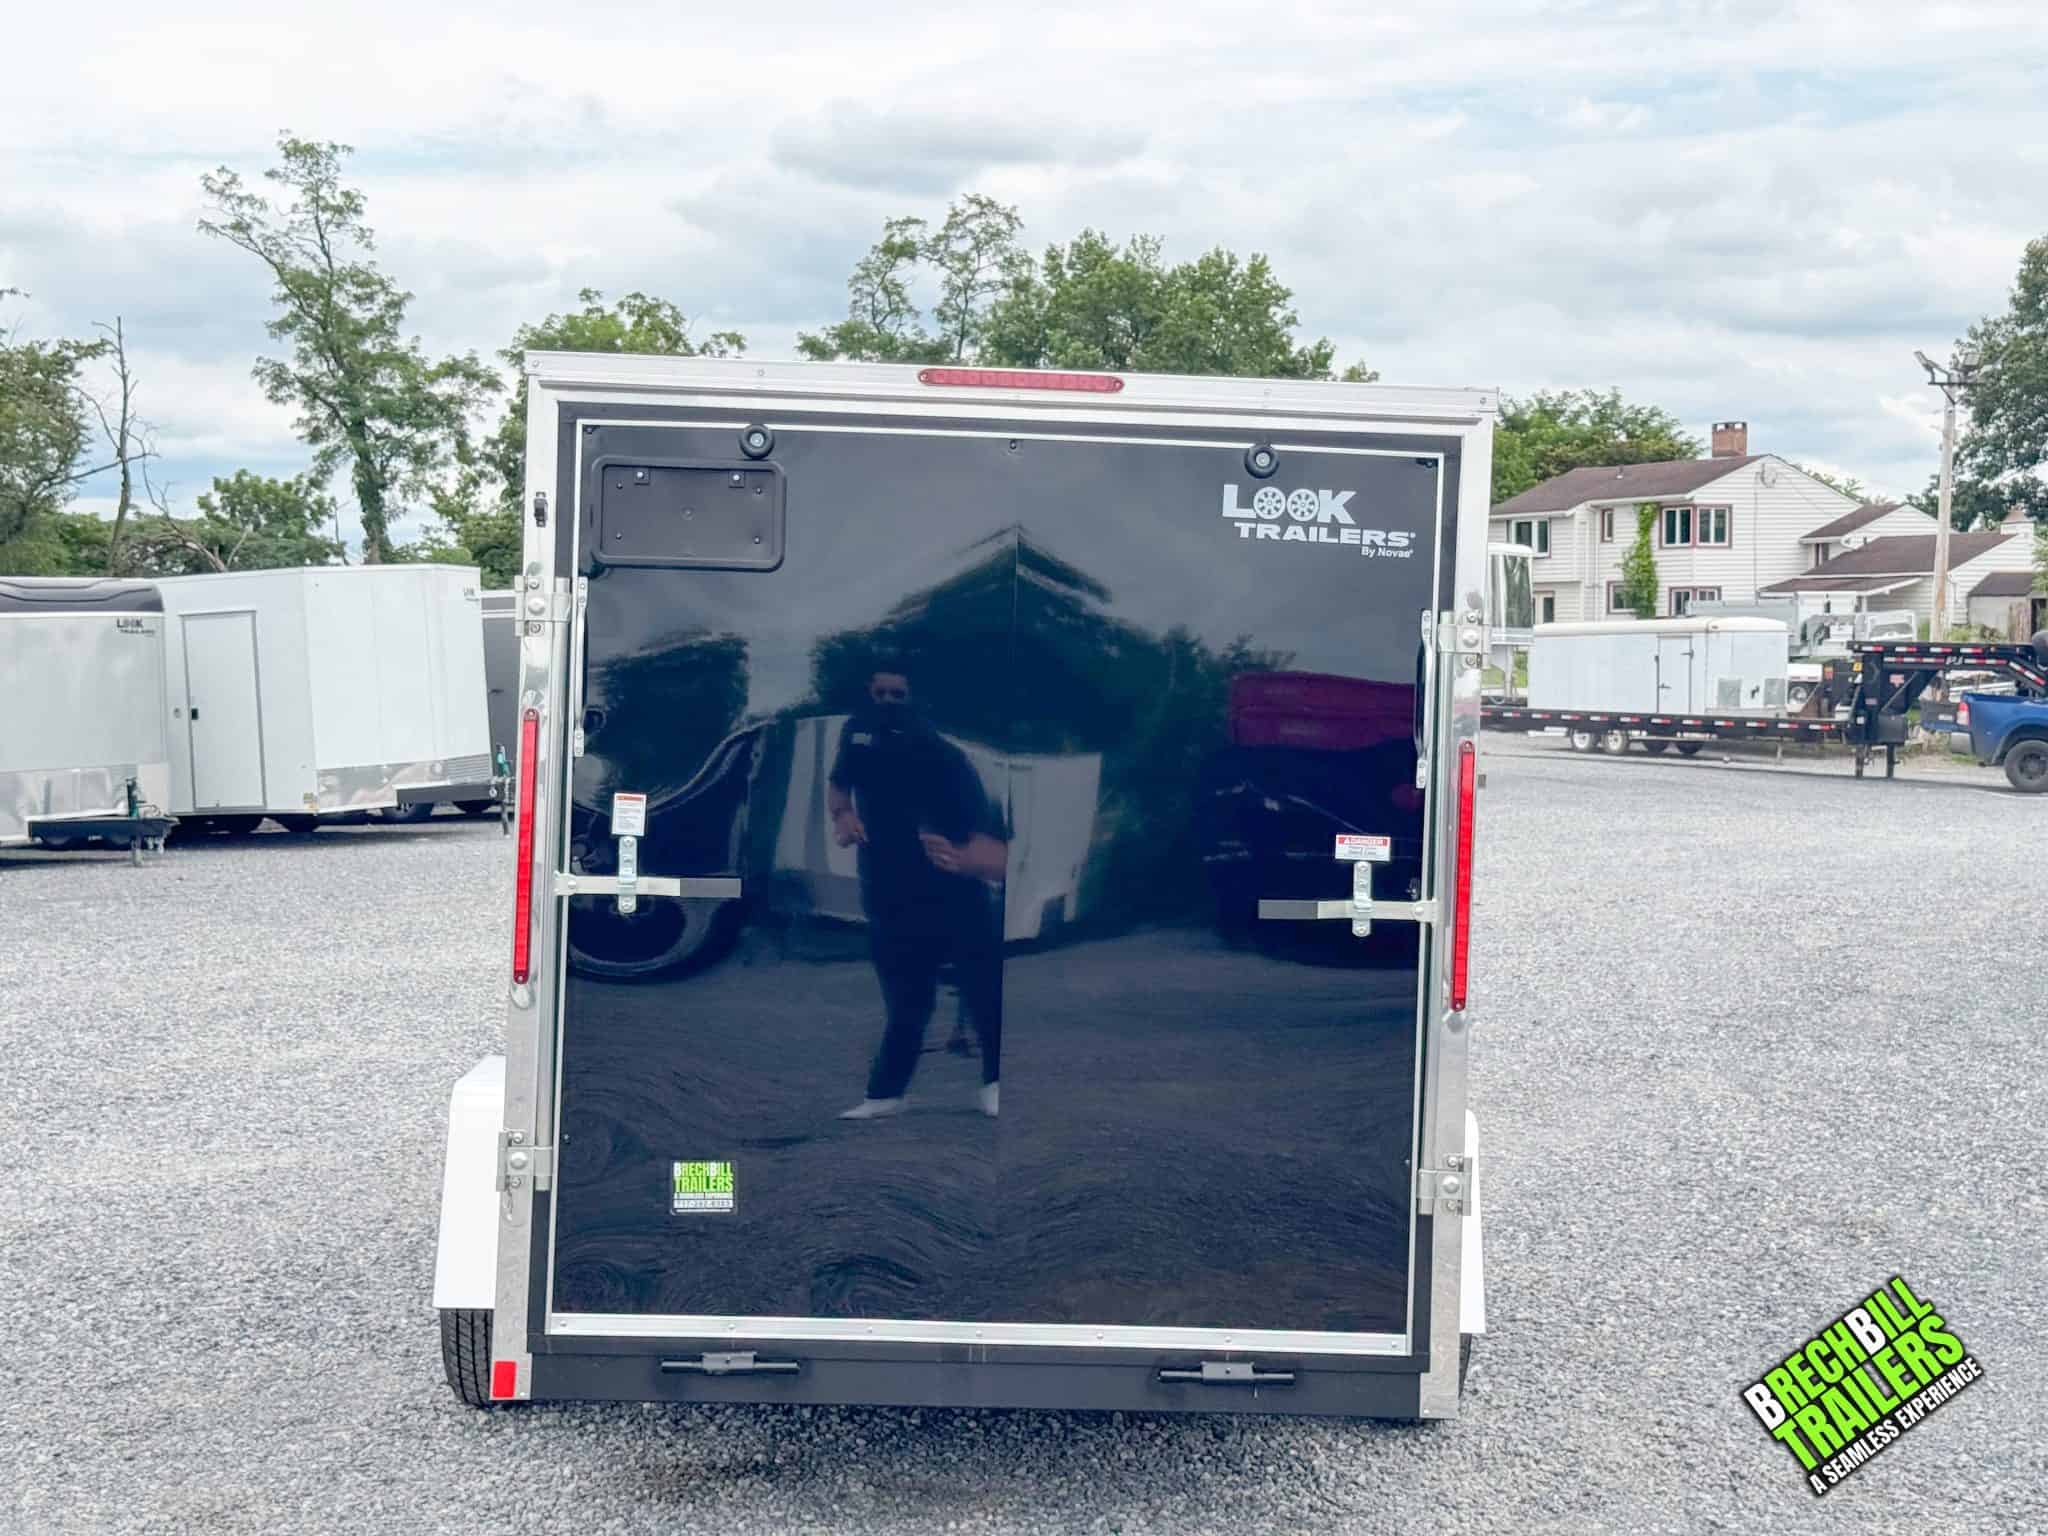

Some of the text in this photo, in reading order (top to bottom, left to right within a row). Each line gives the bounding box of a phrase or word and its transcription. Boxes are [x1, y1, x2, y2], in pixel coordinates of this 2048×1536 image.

[1222, 483, 1357, 525] LOOK
[1361, 546, 1376, 558] By
[673, 1177, 733, 1192] TRAILERS
